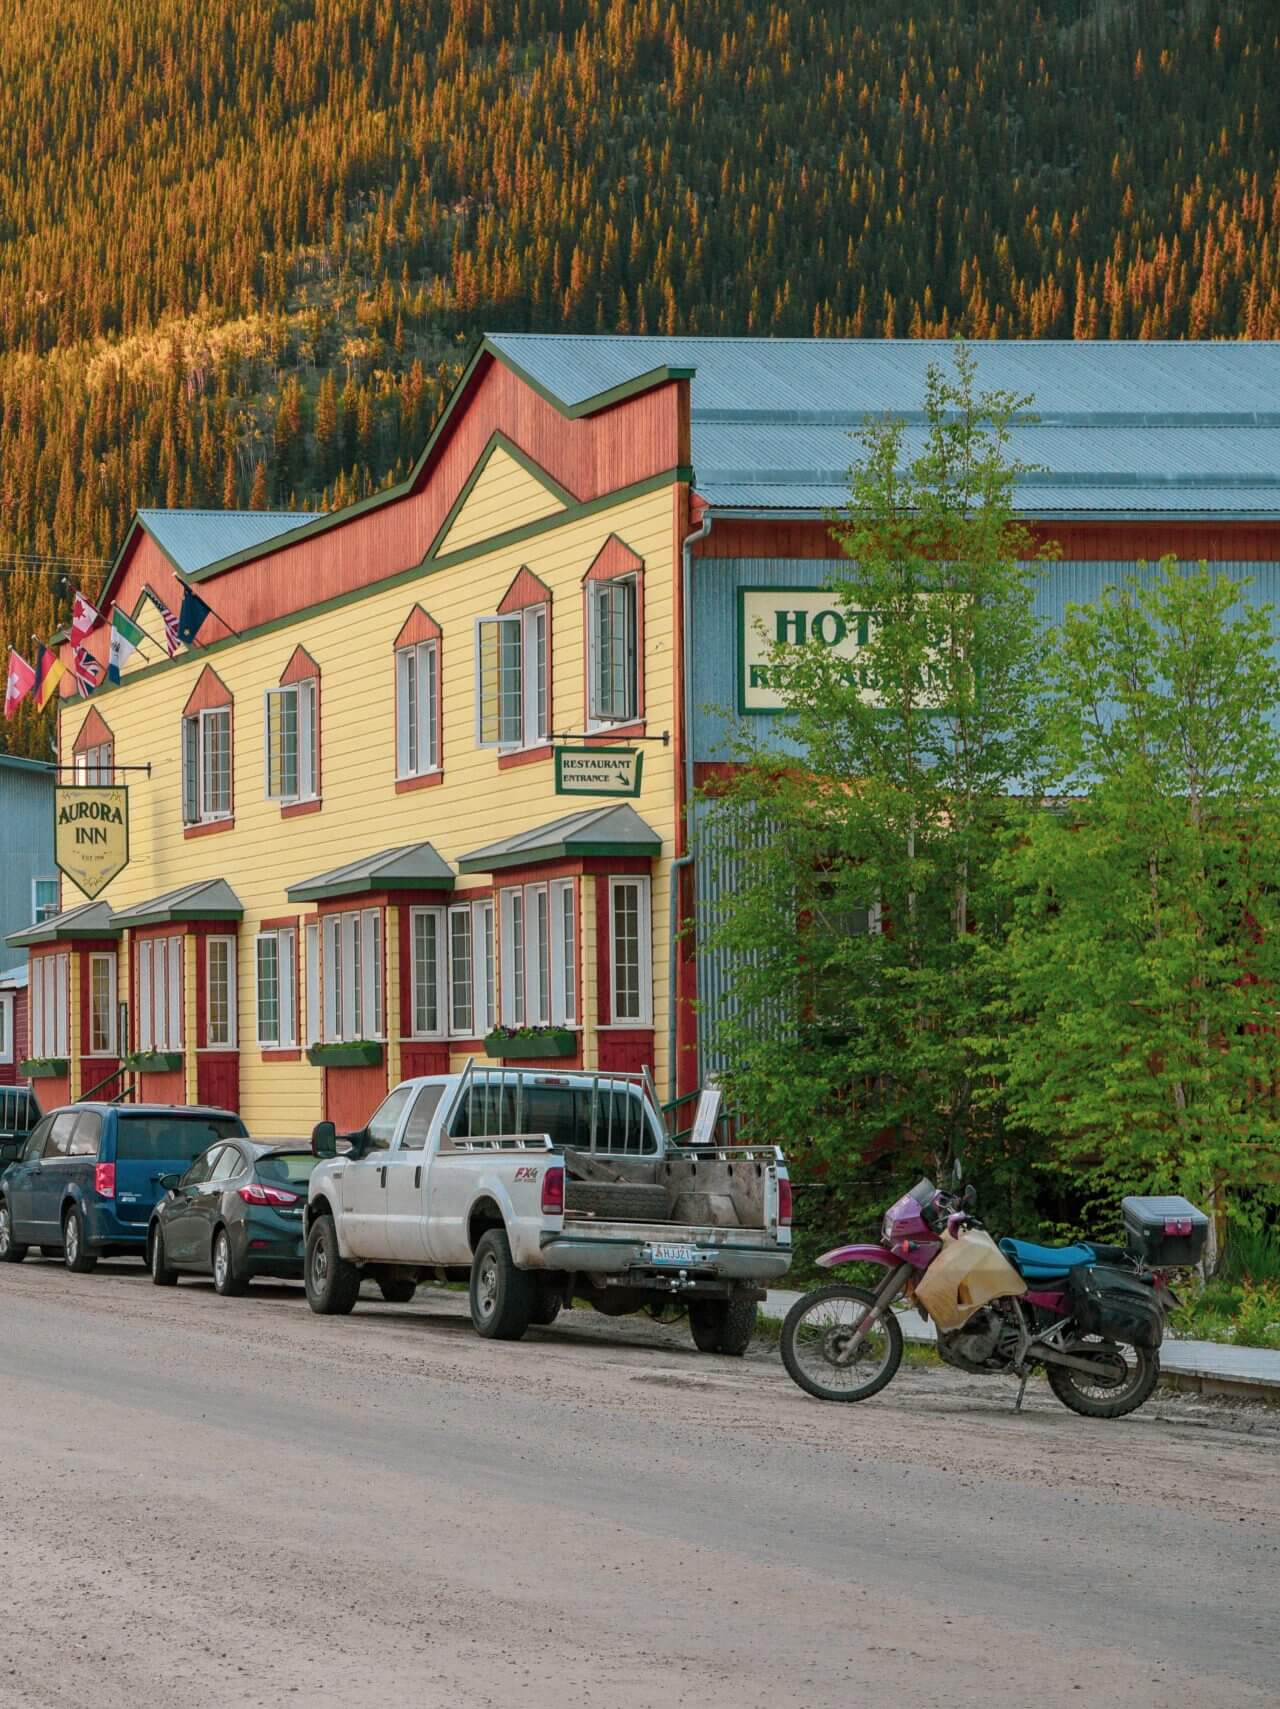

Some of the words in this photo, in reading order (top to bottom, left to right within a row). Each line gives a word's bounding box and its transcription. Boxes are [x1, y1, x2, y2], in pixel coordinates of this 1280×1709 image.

[775, 610, 945, 648] HOT
[562, 759, 632, 769] RESTAURANT
[562, 774, 610, 783] ENTRANCE
[58, 801, 123, 825] AURORA
[75, 827, 107, 845] INN
[515, 1167, 538, 1178] FX4
